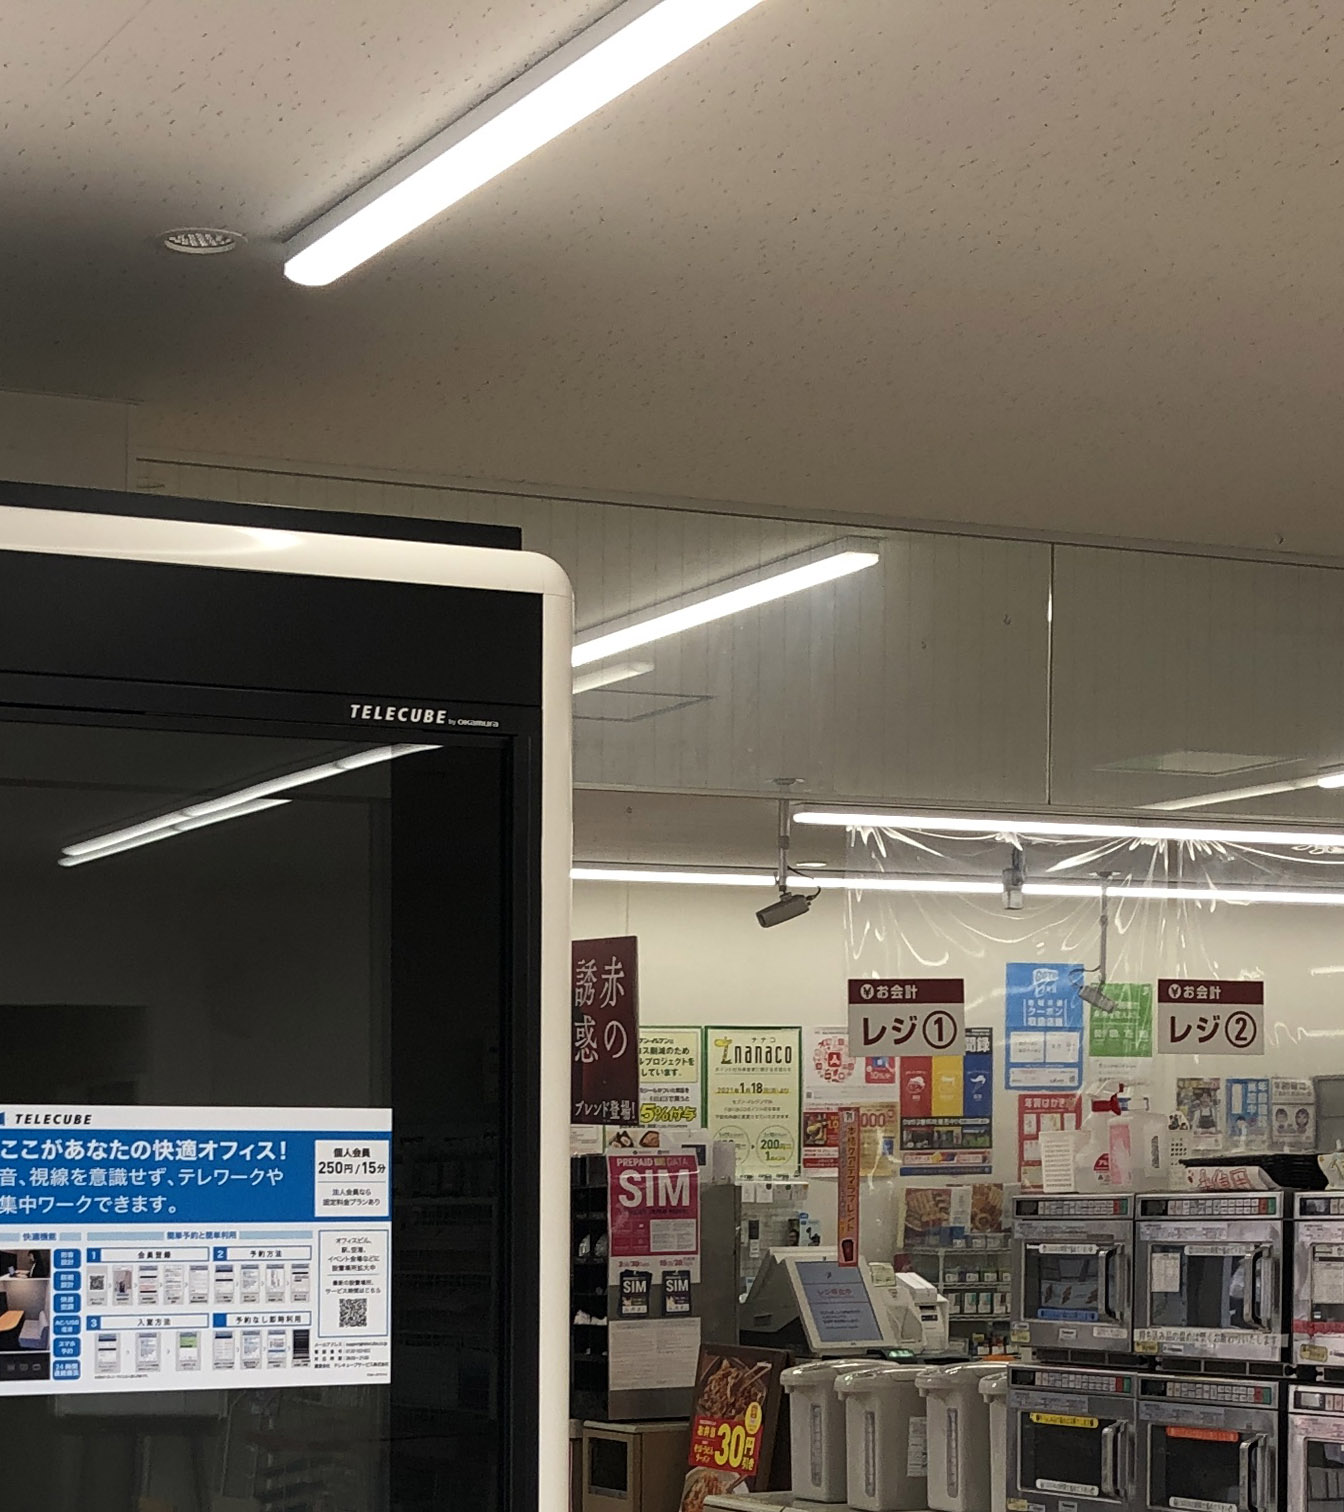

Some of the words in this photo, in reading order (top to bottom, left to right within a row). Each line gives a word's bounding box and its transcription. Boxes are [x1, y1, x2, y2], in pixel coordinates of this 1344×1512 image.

[350, 704, 447, 724] TELECUBE
[600, 956, 628, 1059] 赤の
[734, 1045, 792, 1064] nanaco
[14, 1113, 92, 1125] TELECUBE
[640, 1103, 696, 1123] 5%付与
[333, 1147, 371, 1158] 個人会員
[617, 1157, 653, 1166] PREPAID
[0, 1167, 284, 1187] 音、視線を意識せず、テレワークや
[618, 1168, 690, 1207] SIM
[137, 1251, 172, 1259] 会員登録
[216, 1250, 224, 1258] 2
[250, 1250, 282, 1258] 予約方法
[622, 1280, 647, 1294] SIM
[666, 1279, 689, 1293] SIM
[90, 1318, 97, 1327] 3
[714, 1423, 746, 1468] 30
[744, 1436, 756, 1456] 円
